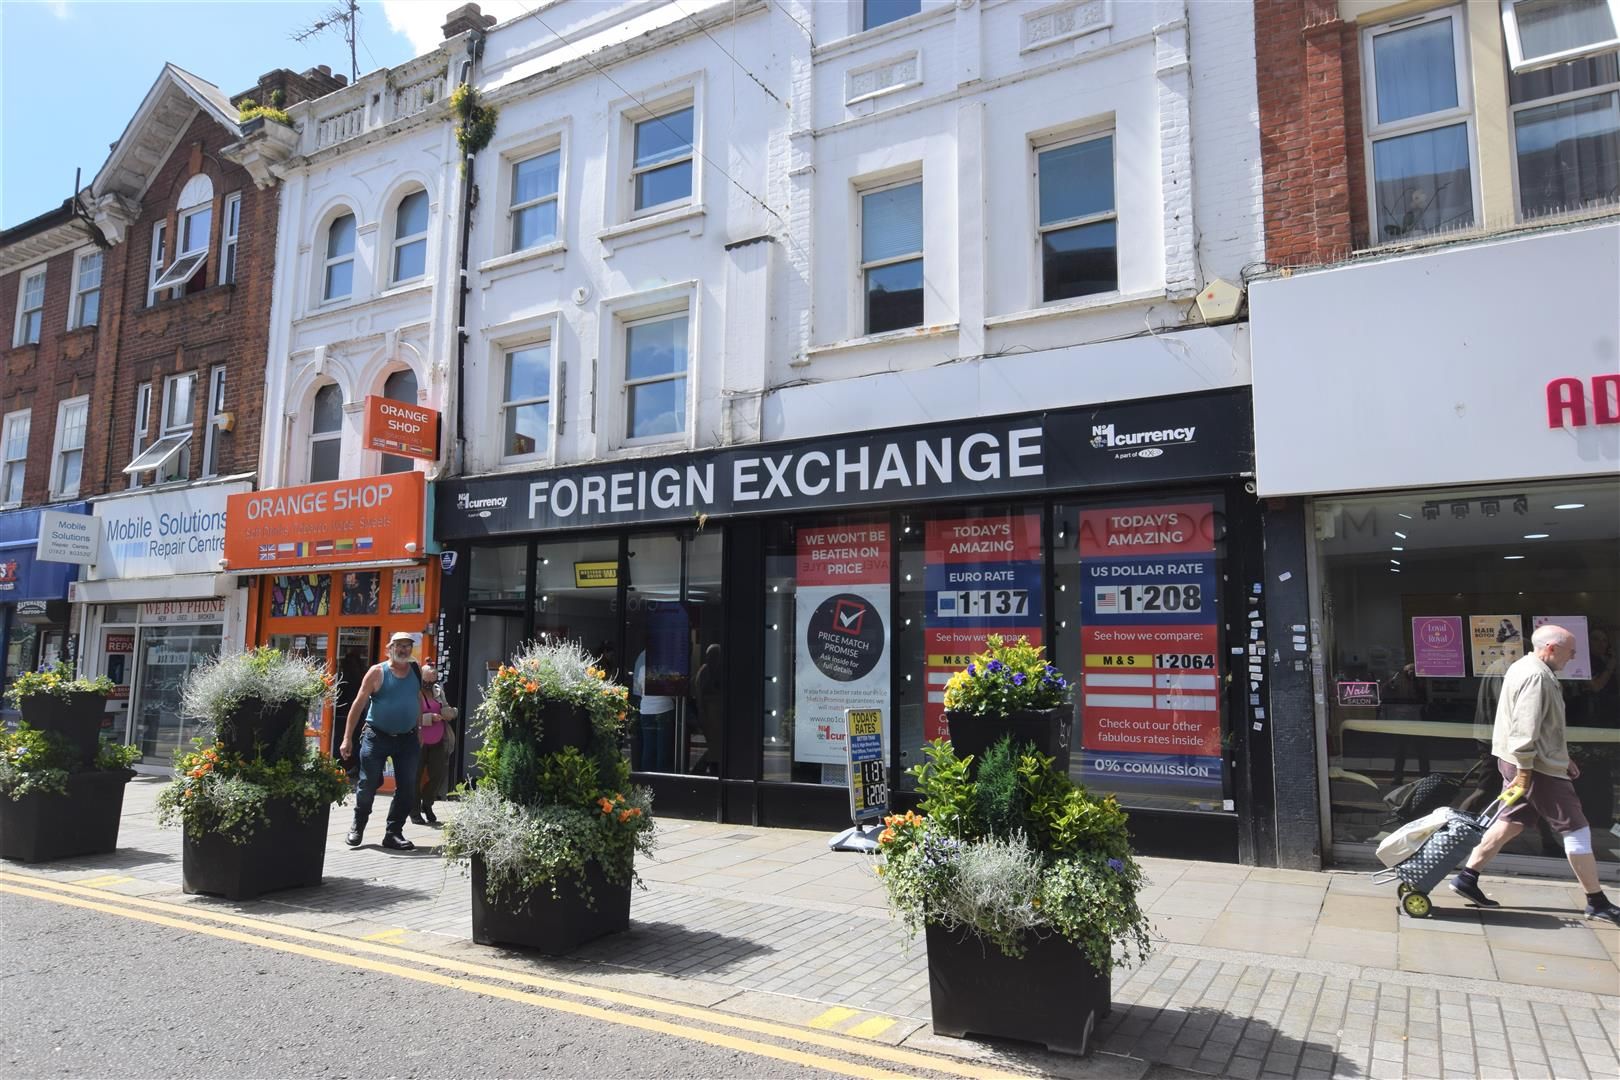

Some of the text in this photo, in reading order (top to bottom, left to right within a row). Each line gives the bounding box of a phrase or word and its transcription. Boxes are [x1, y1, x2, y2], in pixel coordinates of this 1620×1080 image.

[380, 404, 429, 423] ORANGE
[388, 419, 421, 433] SHOP
[528, 427, 1044, 519] FOREIGN EXCHANGE
[247, 483, 393, 519] ORANGE SHOP
[58, 520, 87, 531] Mobile
[106, 508, 228, 541] Mobile Solutions
[1112, 513, 1178, 529] TODAY'S
[51, 531, 92, 542] Solutions
[806, 531, 886, 545] WE WON'T BE
[953, 524, 1011, 538] TODAY'S
[1107, 531, 1183, 546] AMAZING
[149, 535, 226, 559] Repair Centre
[812, 547, 879, 560] BEATEN ON
[949, 540, 1015, 554] AMAZING
[827, 563, 863, 575] PRICE
[1091, 563, 1204, 577] US DOLLAR RATE
[949, 571, 1015, 582] EURO RATE
[144, 602, 161, 615] WE
[163, 601, 186, 614] BUY
[818, 631, 869, 650] PRICE MATCH
[936, 633, 952, 642] See
[953, 632, 971, 642] how
[1094, 631, 1112, 640] See
[1114, 631, 1136, 640] how
[1154, 632, 1203, 642] compare:
[824, 642, 860, 658] PROMISE
[820, 653, 859, 668] Ask inside for
[823, 662, 853, 675] full details
[1344, 684, 1370, 697] Nail
[852, 712, 878, 723] TODAYS
[1099, 718, 1202, 731] Check out our other
[855, 723, 876, 734] RATES
[1098, 732, 1204, 746] fabulous rates inside
[1095, 759, 1209, 777] 0% COMMISSION
